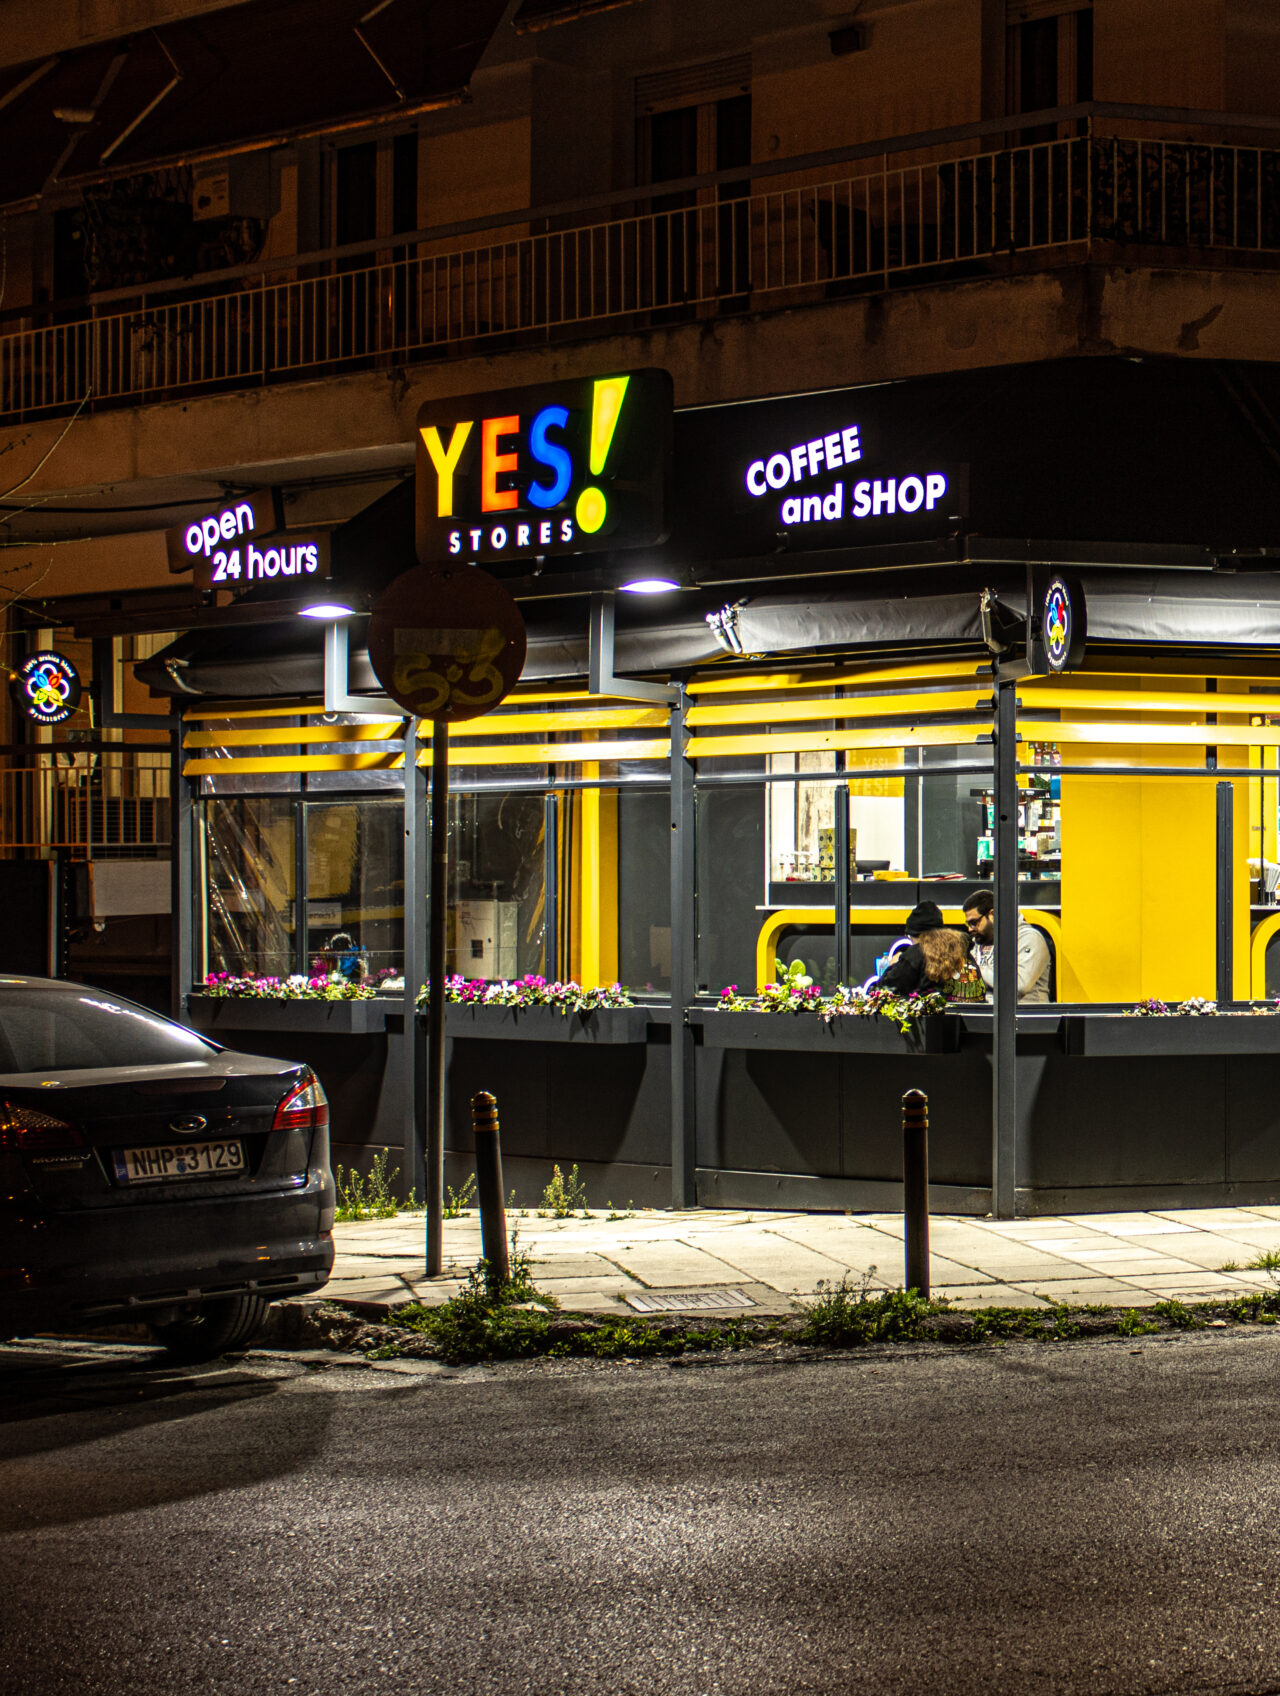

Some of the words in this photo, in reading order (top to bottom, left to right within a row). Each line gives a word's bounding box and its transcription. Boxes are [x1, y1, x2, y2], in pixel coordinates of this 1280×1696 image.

[419, 376, 630, 534] YES!
[746, 425, 861, 496] COFFEE
[782, 482, 843, 524] and
[852, 474, 947, 518] SHOP
[185, 503, 255, 557] open
[449, 518, 573, 554] STORES
[212, 549, 241, 581] 24
[247, 544, 318, 579] hours
